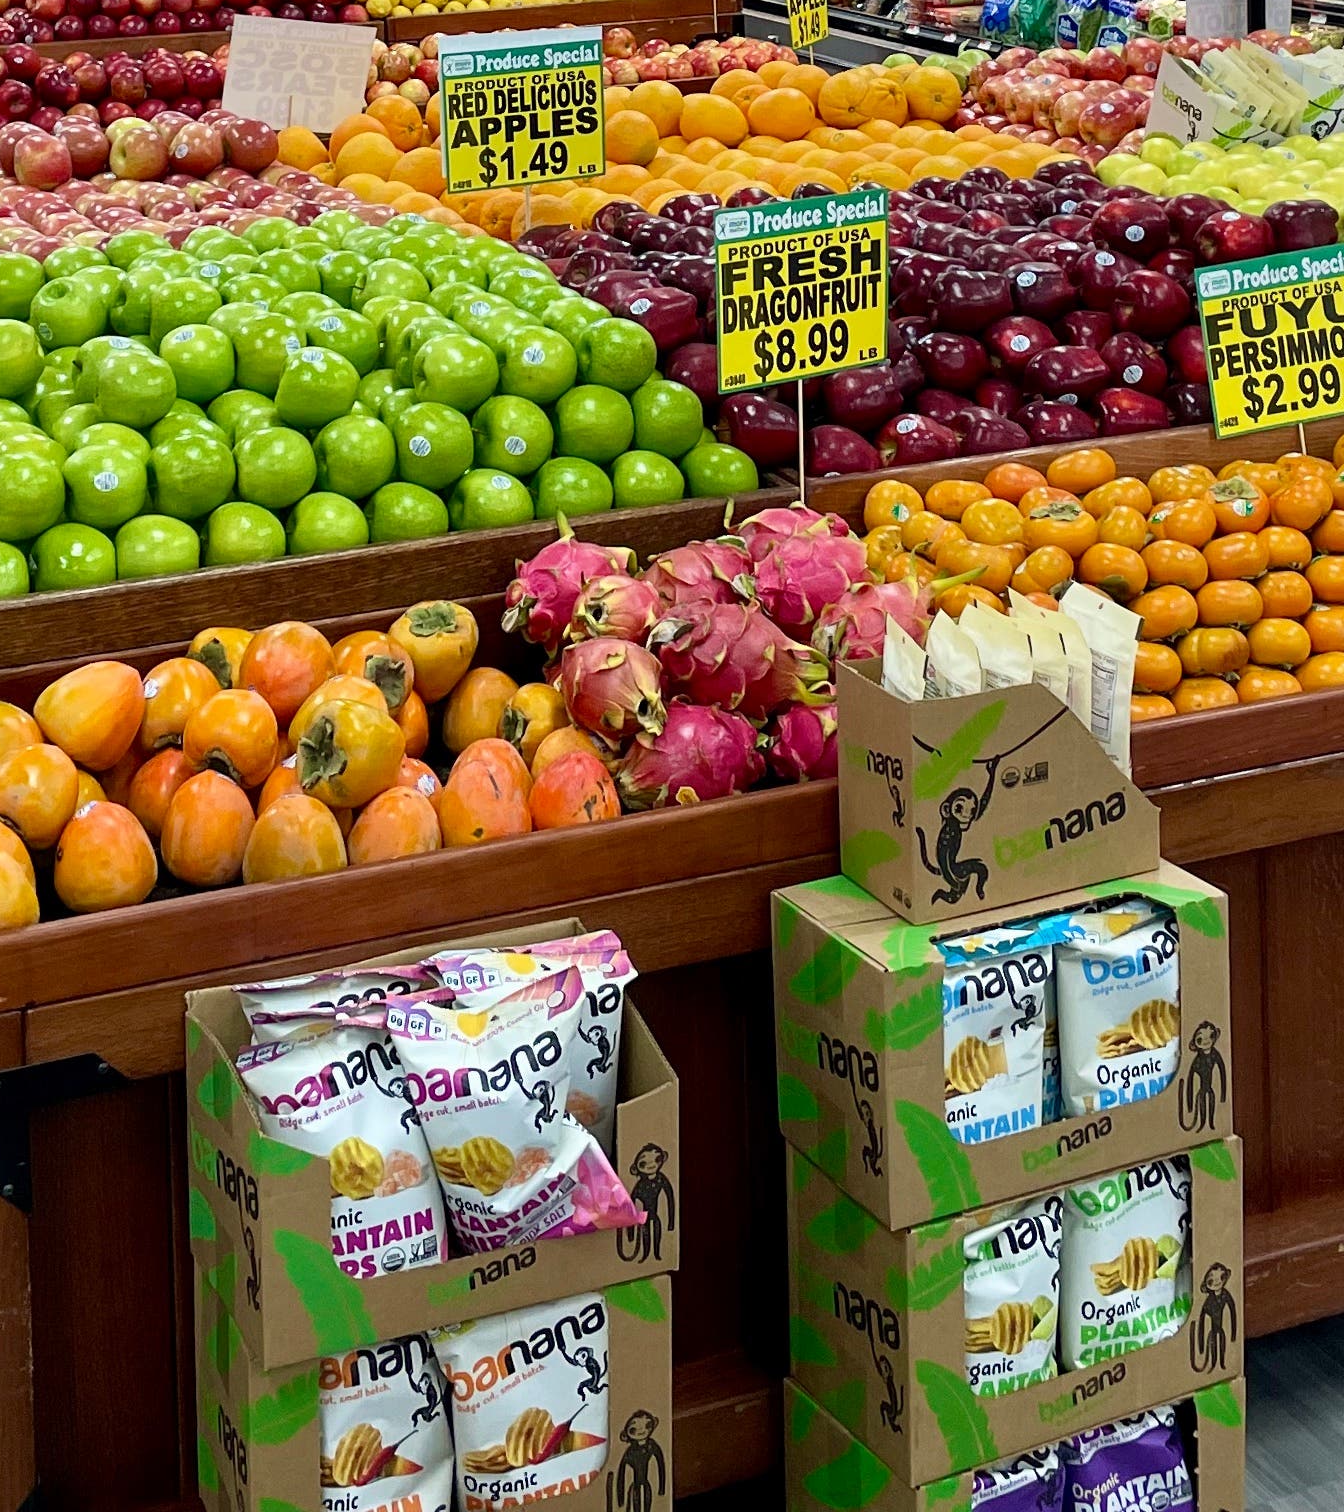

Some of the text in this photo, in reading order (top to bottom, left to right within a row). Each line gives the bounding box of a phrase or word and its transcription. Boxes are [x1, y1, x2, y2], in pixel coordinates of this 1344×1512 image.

[797, 11, 820, 45] $1.49
[475, 44, 599, 73] Produce Special
[454, 70, 586, 92] PRODUCT OF USA
[448, 80, 597, 120] RED DELICIOUS
[451, 107, 598, 149] APPLES
[479, 141, 596, 187] $1.49 LB
[752, 207, 822, 233] Produce
[826, 194, 885, 227] Special
[728, 228, 871, 260] PRODUCT OF USA
[721, 239, 881, 296] FRESH
[1232, 264, 1299, 291] Produce
[723, 273, 881, 334] DRAGONFRUIT
[1222, 281, 1342, 312] PRODUCT OF USA
[753, 319, 877, 382] $8.99 LB
[1242, 364, 1341, 423] $2.99
[1097, 1058, 1161, 1088] Organic
[1080, 1292, 1190, 1345] PLANTAIN
[1081, 1294, 1141, 1325] Organic
[463, 1472, 537, 1502] Organic
[1073, 1472, 1121, 1500] Organic
